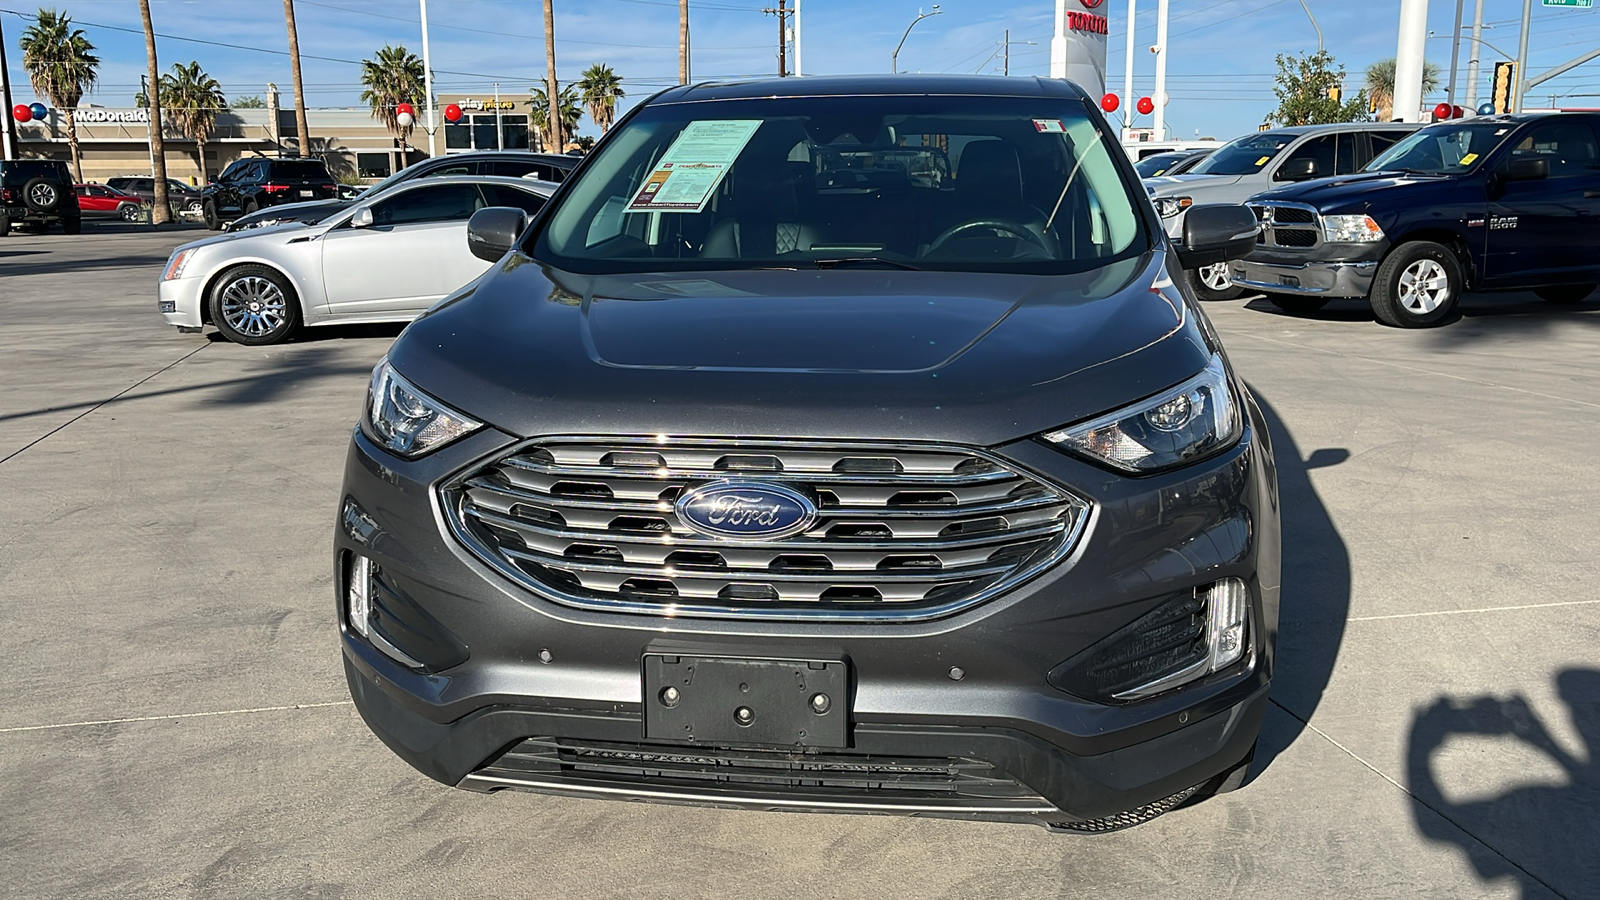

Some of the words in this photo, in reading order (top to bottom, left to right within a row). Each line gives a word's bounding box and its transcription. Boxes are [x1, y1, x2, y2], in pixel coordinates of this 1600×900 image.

[1067, 11, 1108, 35] TOYOTA
[73, 110, 151, 122] McDonald
[708, 495, 780, 525] Ford
